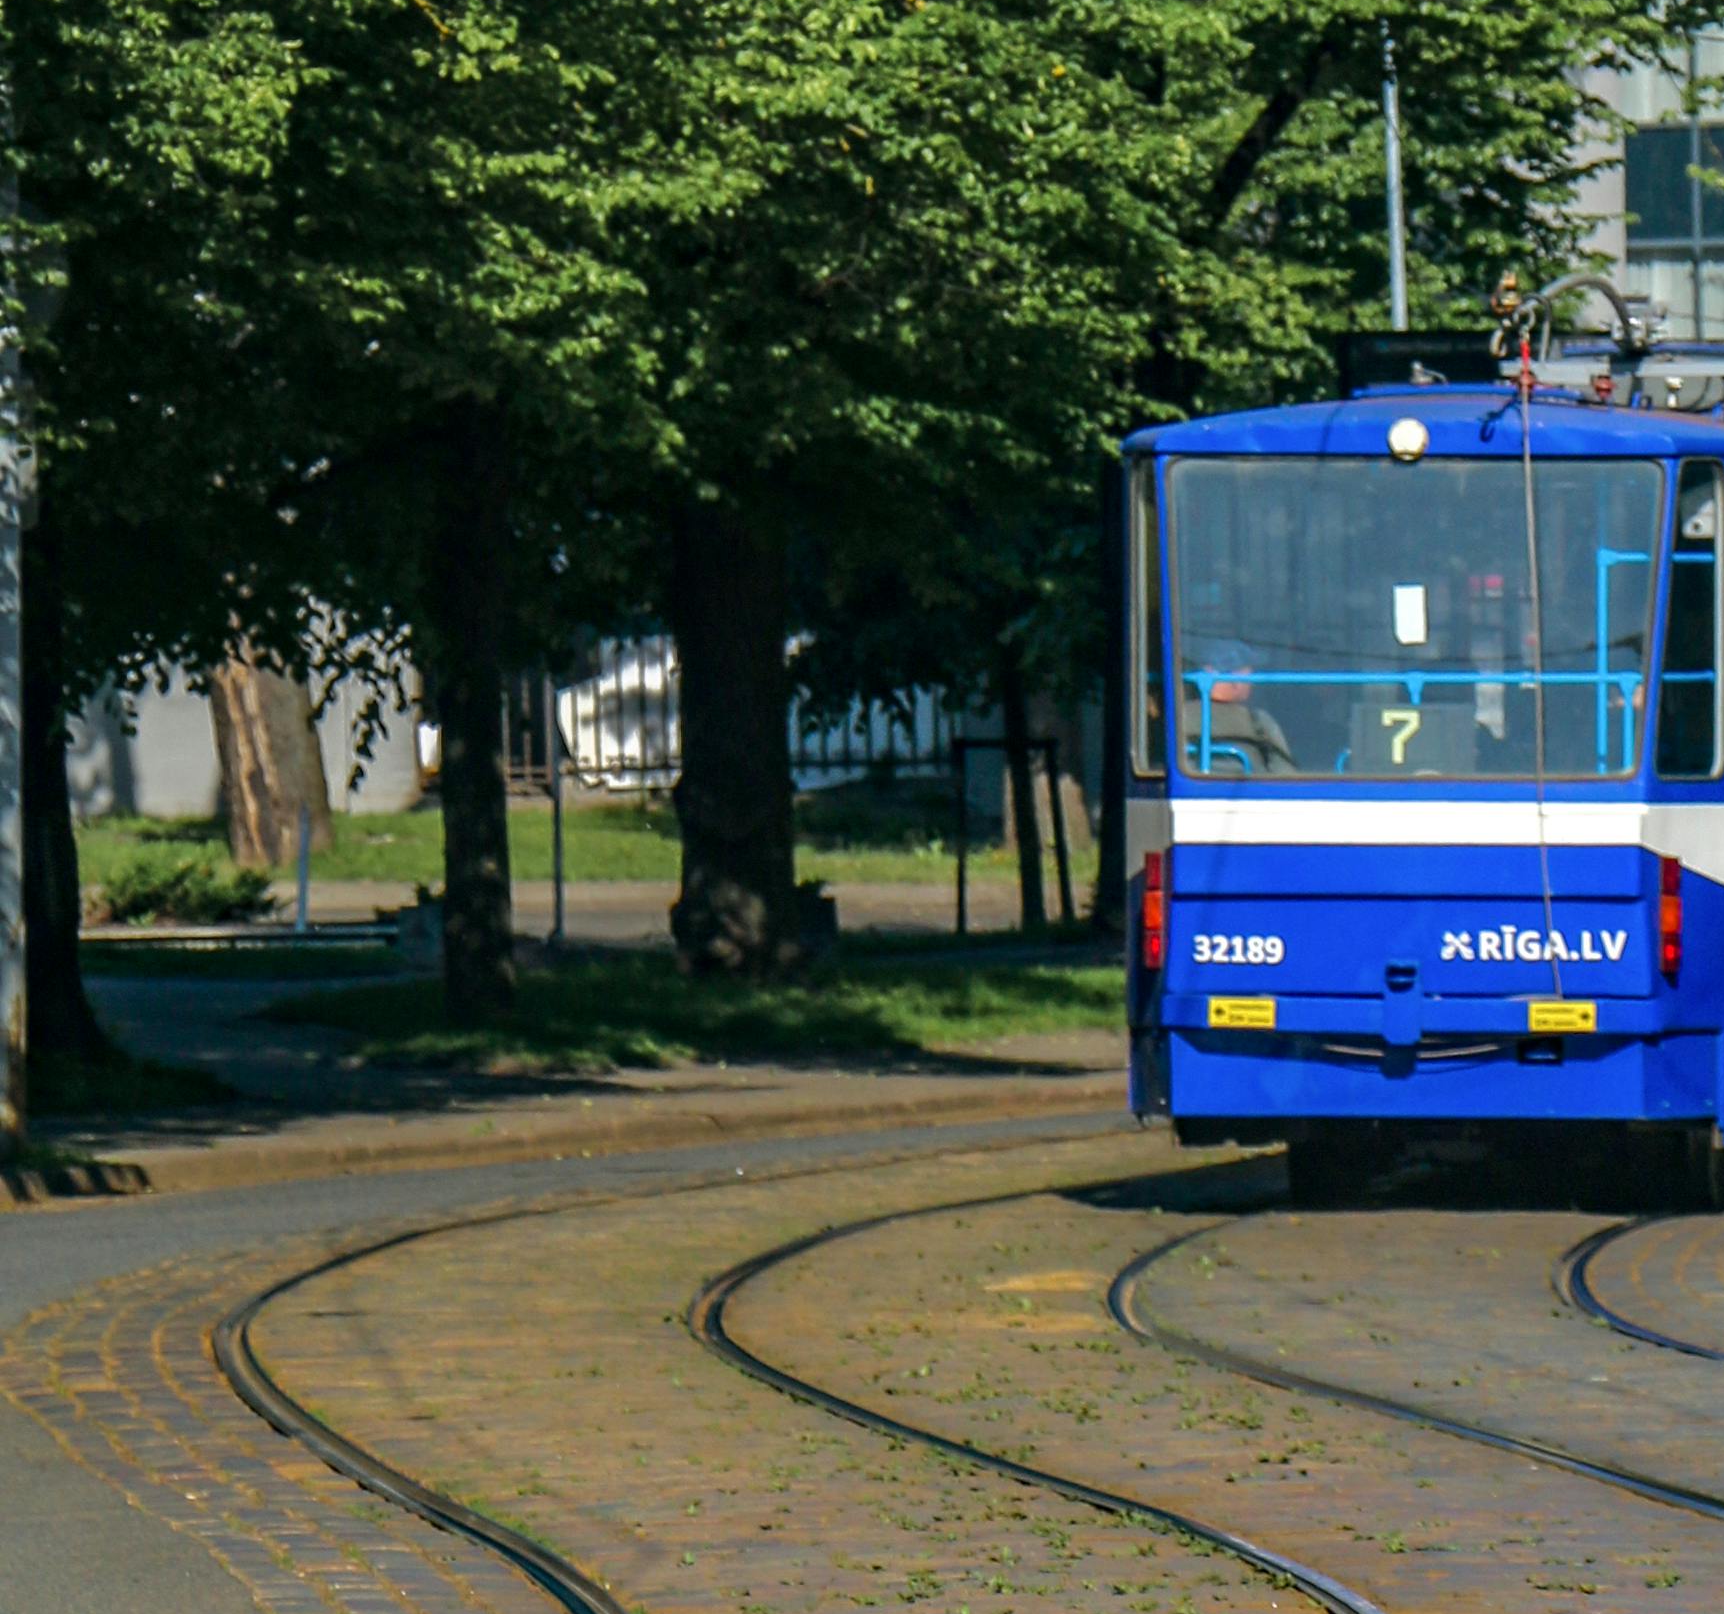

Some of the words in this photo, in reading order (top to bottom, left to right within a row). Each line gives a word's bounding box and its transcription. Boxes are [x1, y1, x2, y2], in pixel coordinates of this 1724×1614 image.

[1381, 709, 1420, 764] 7
[1193, 934, 1285, 964] 32189
[1479, 925, 1627, 961] RĪGA.LV
